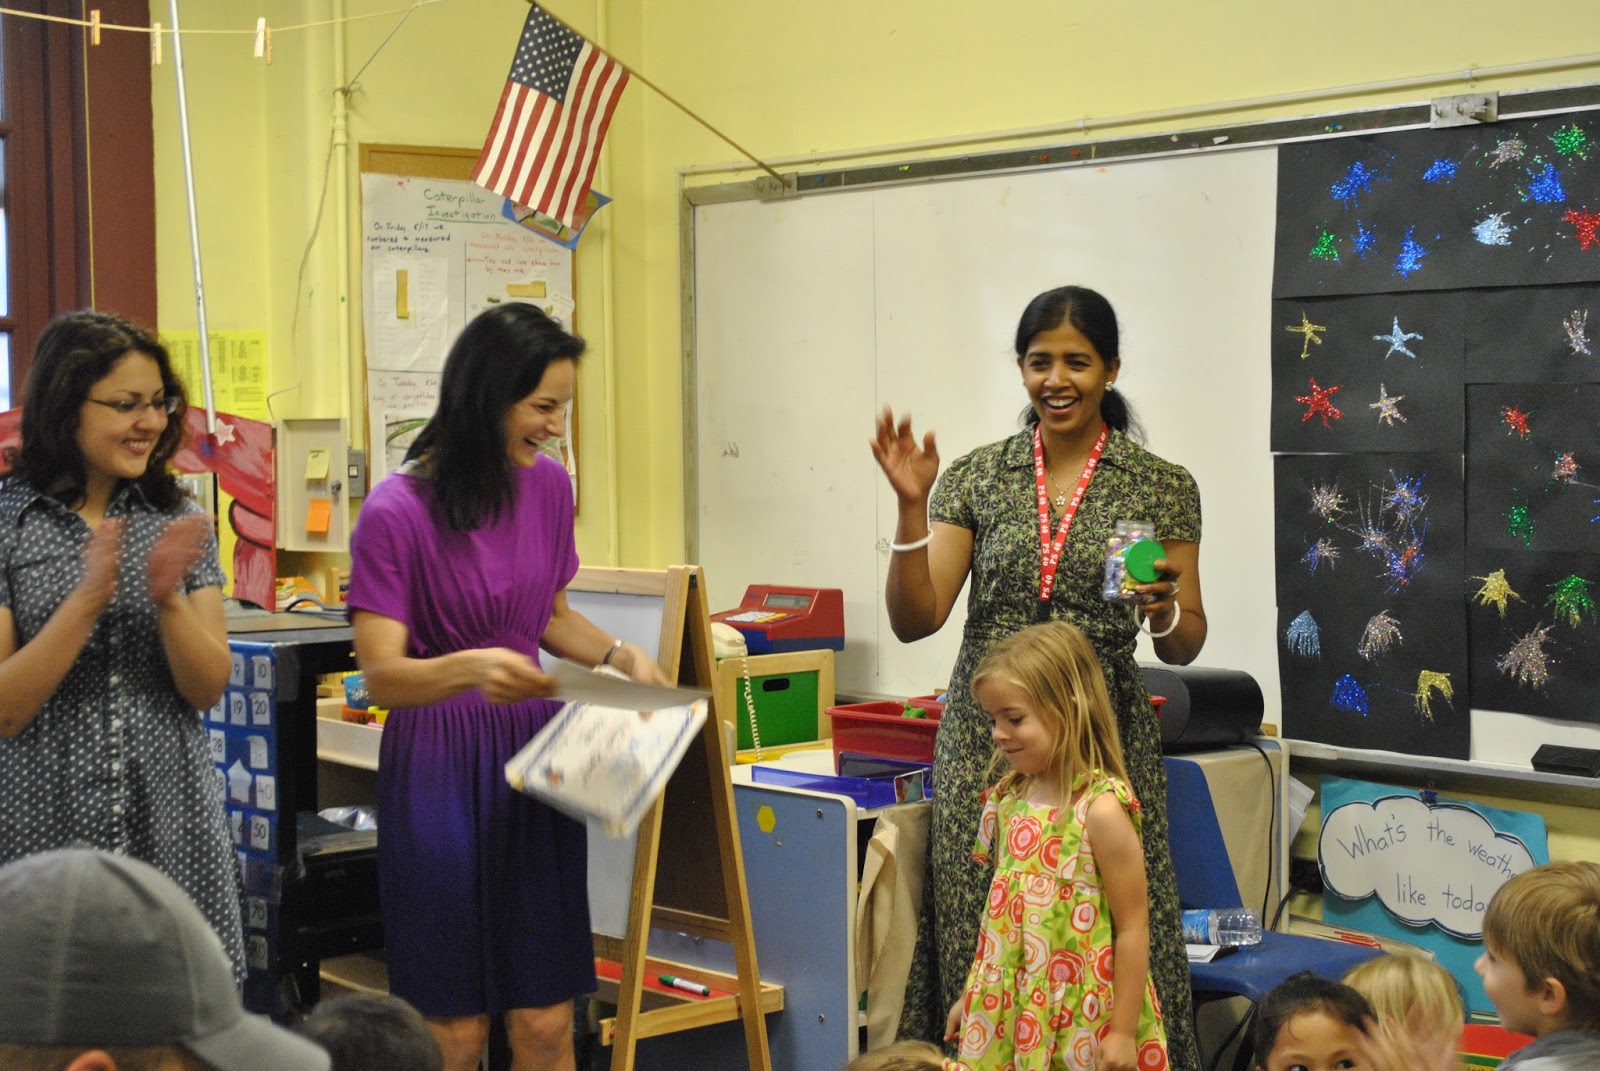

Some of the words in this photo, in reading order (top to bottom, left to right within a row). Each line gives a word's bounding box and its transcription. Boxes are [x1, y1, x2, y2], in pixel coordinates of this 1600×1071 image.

[423, 188, 485, 208] Caterpillar
[426, 205, 496, 221] Investigation
[374, 222, 383, 231] On
[415, 233, 451, 242] measured
[1082, 468, 1092, 479] PS
[1087, 458, 1097, 468] 40
[1038, 484, 1046, 496] PS
[1070, 496, 1080, 507] PS
[1075, 486, 1085, 496] 40
[1040, 513, 1048, 523] PS
[1059, 523, 1069, 534] PS
[1064, 513, 1073, 523] 40
[1042, 543, 1050, 554] PS
[1053, 542, 1062, 552] 40
[1042, 556, 1050, 566] 40
[1049, 553, 1059, 565] PS
[1045, 574, 1053, 585] 40
[1041, 586, 1051, 599] PS
[233, 663, 240, 677] 9
[257, 663, 267, 678] 10
[233, 700, 243, 714] 19
[254, 700, 267, 715] 20
[212, 737, 223, 753] 28
[257, 784, 273, 800] 40
[253, 823, 267, 839] 50
[1336, 813, 1407, 860] What's
[1427, 816, 1456, 846] the
[1468, 839, 1518, 879] weathe
[1396, 872, 1427, 906] like
[1441, 884, 1488, 912] toda
